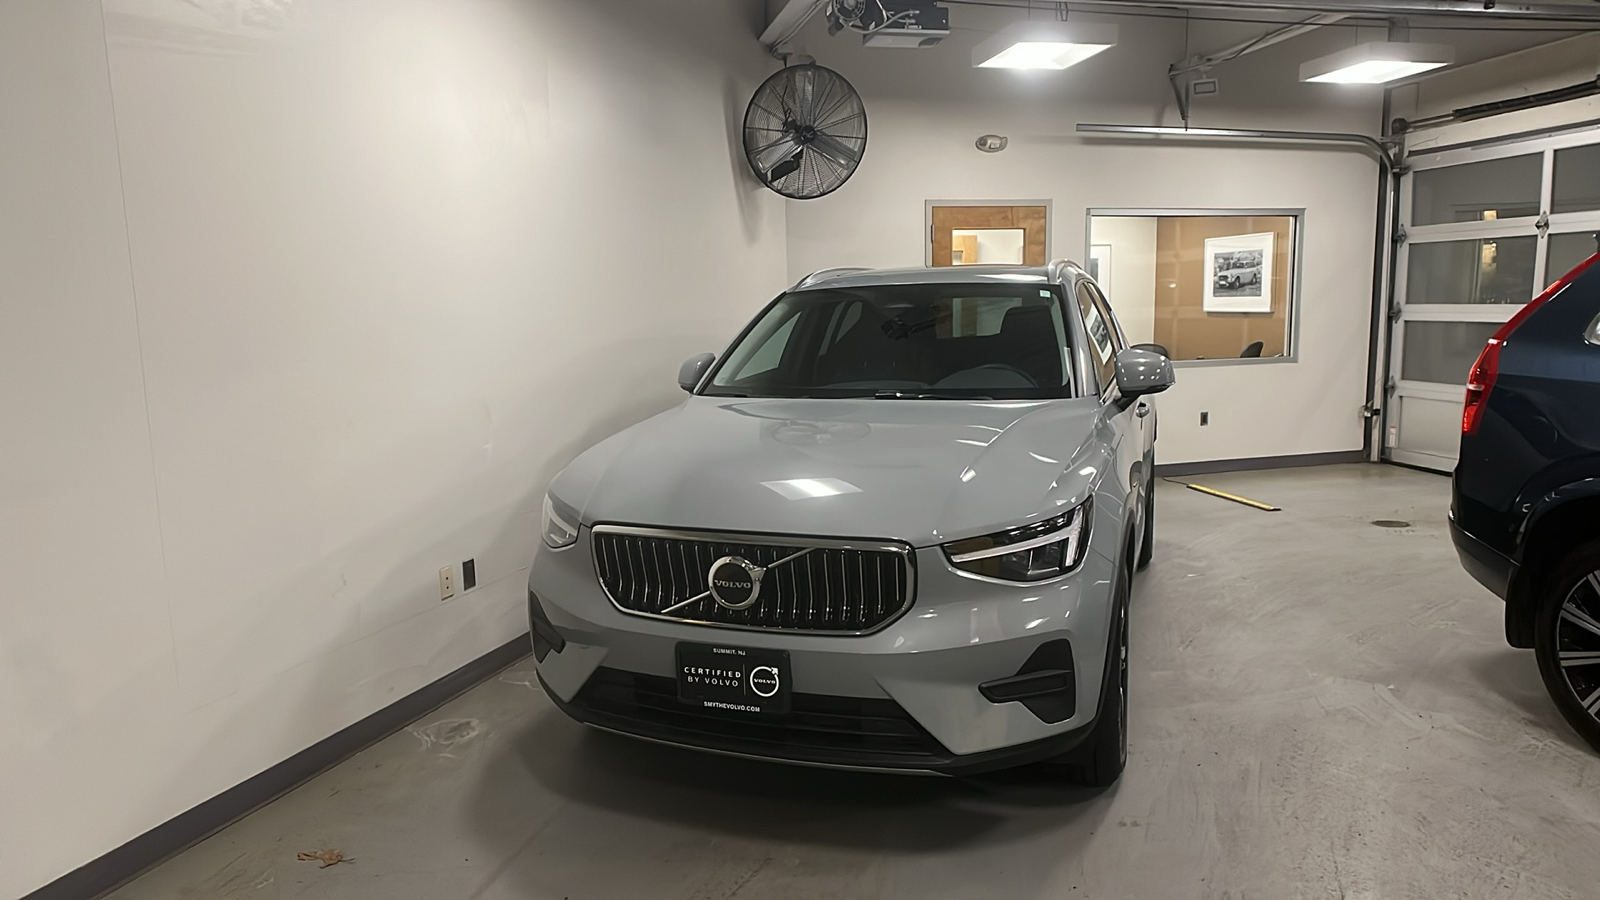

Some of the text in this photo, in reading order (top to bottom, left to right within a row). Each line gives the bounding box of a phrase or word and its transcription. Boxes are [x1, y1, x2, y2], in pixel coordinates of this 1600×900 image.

[714, 579, 751, 588] VOLVO
[684, 666, 741, 678] CERTIFIED
[705, 678, 738, 686] VOLVO
[704, 701, 760, 712] SMYTHEVOLVO.COM
